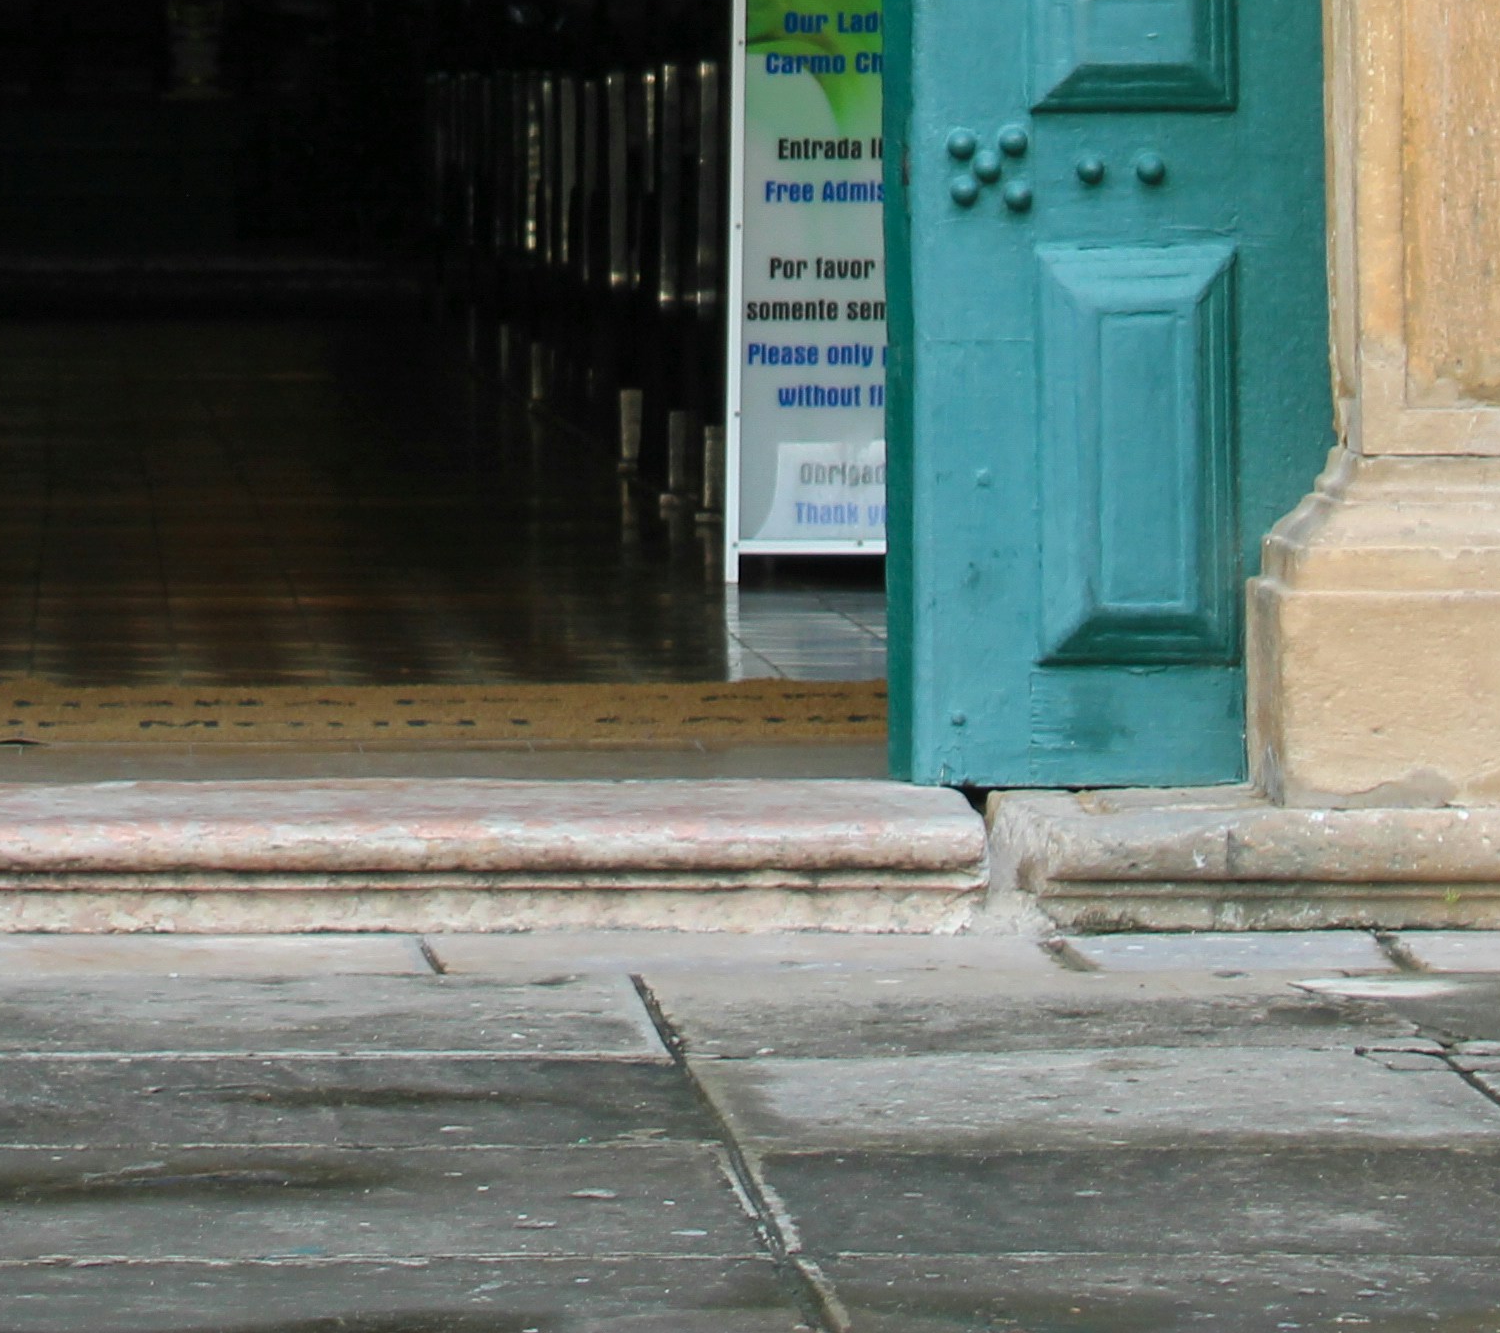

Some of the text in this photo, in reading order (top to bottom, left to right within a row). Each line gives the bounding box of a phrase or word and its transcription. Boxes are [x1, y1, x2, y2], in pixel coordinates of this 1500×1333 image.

[783, 11, 882, 34] Our Lad
[765, 52, 846, 75] Carmo
[778, 137, 863, 161] Entrada
[765, 180, 886, 204] Free Admis
[769, 256, 876, 280] Por favor
[746, 299, 839, 322] somente
[747, 342, 820, 366] Please
[827, 342, 875, 368] only
[778, 384, 862, 408] without
[796, 501, 859, 525] Thank
